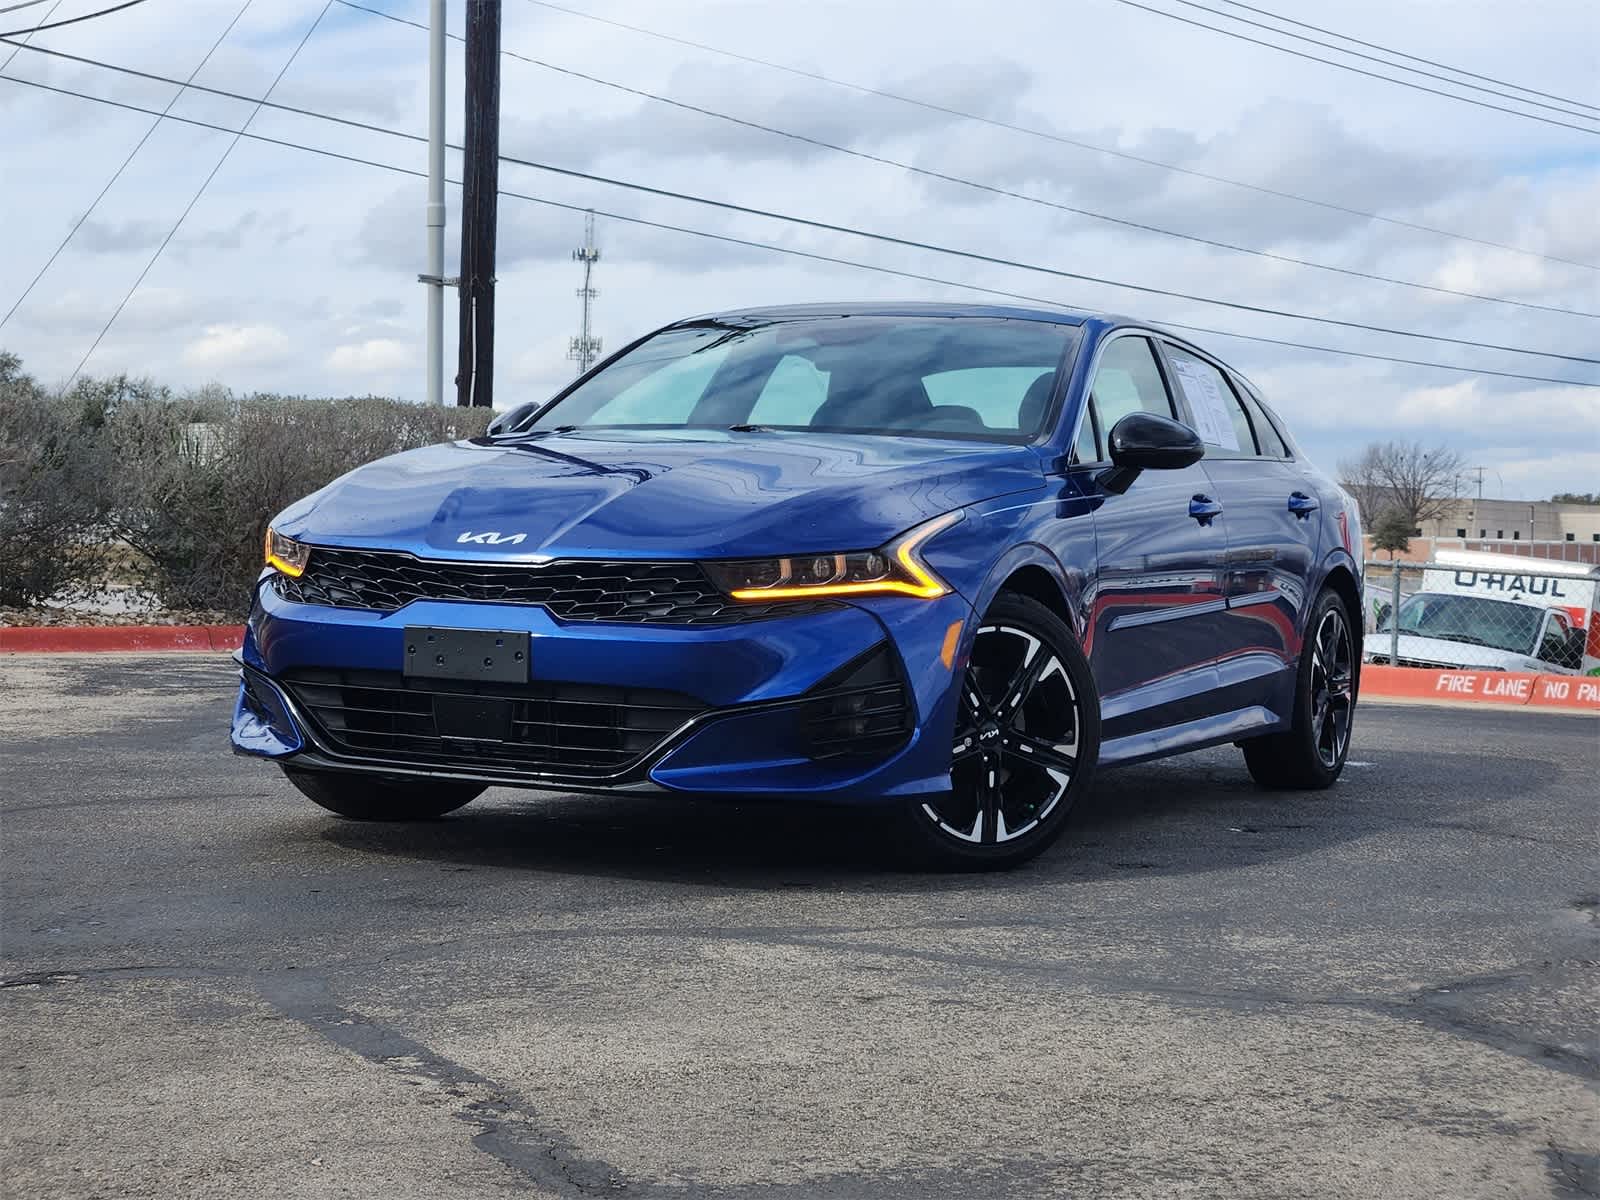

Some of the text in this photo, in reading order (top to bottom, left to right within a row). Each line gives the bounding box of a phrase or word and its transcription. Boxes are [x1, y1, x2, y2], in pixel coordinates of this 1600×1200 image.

[1455, 570, 1566, 597] U-HAUL
[1435, 674, 1600, 701] FIRE LANE NO PA
